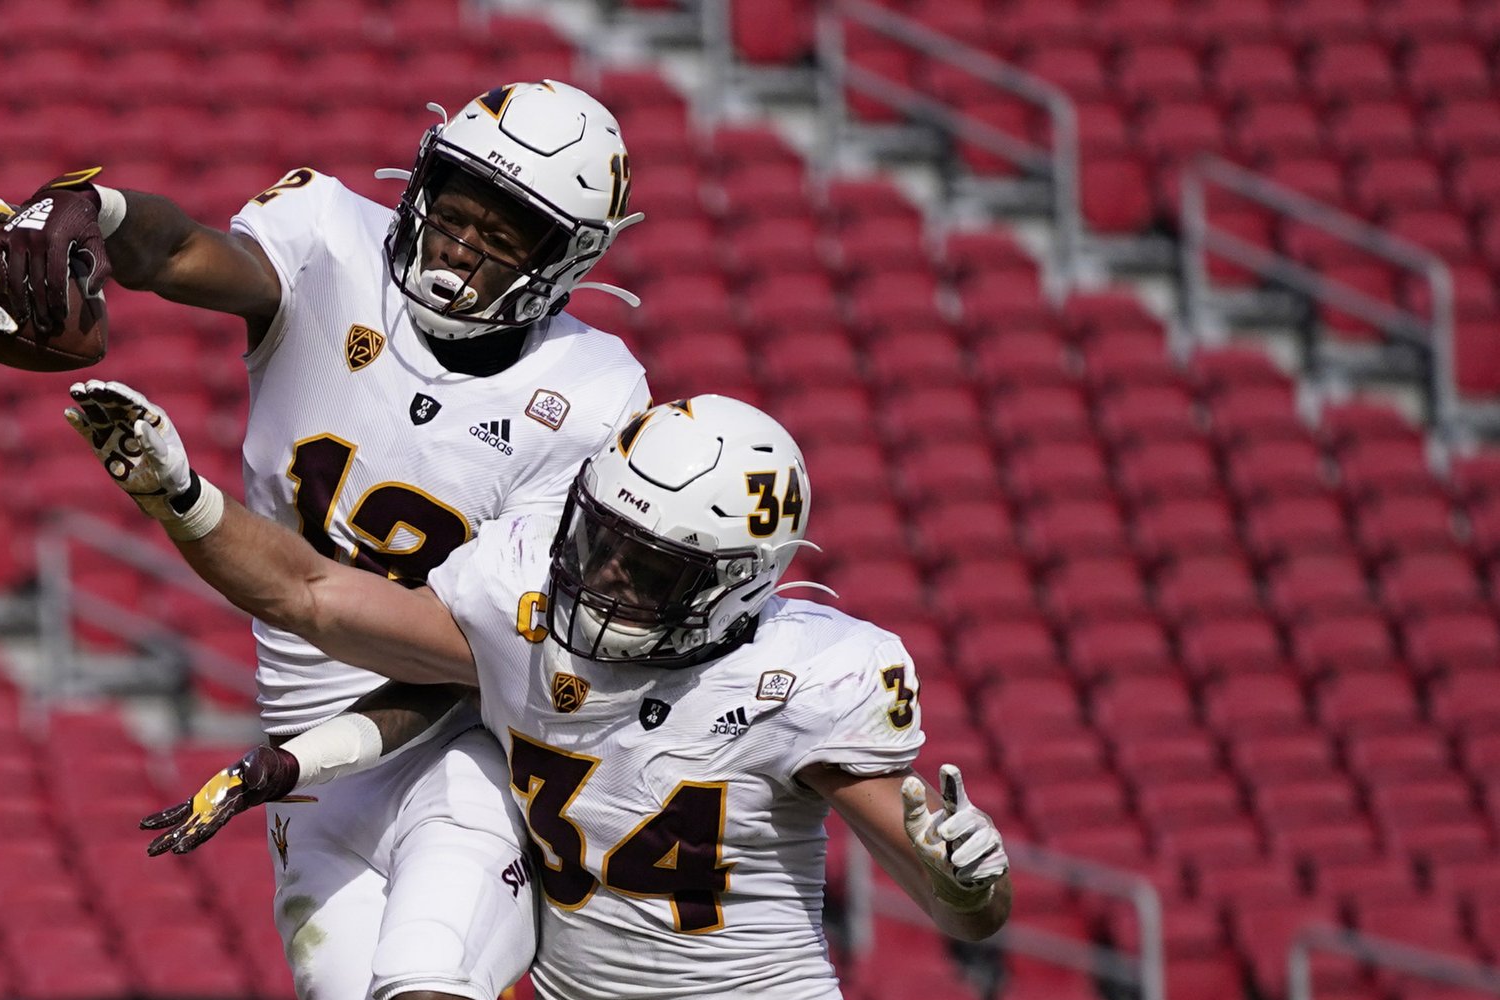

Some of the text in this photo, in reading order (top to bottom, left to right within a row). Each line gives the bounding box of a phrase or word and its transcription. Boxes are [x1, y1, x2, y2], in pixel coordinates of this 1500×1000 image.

[349, 326, 382, 357] PAC
[349, 344, 370, 364] 12
[468, 425, 514, 456] adidas
[286, 432, 472, 590] 12
[744, 466, 803, 538] 34
[516, 591, 549, 644] C
[554, 675, 586, 704] PAC
[556, 692, 575, 711] 12
[508, 726, 739, 934] 34
